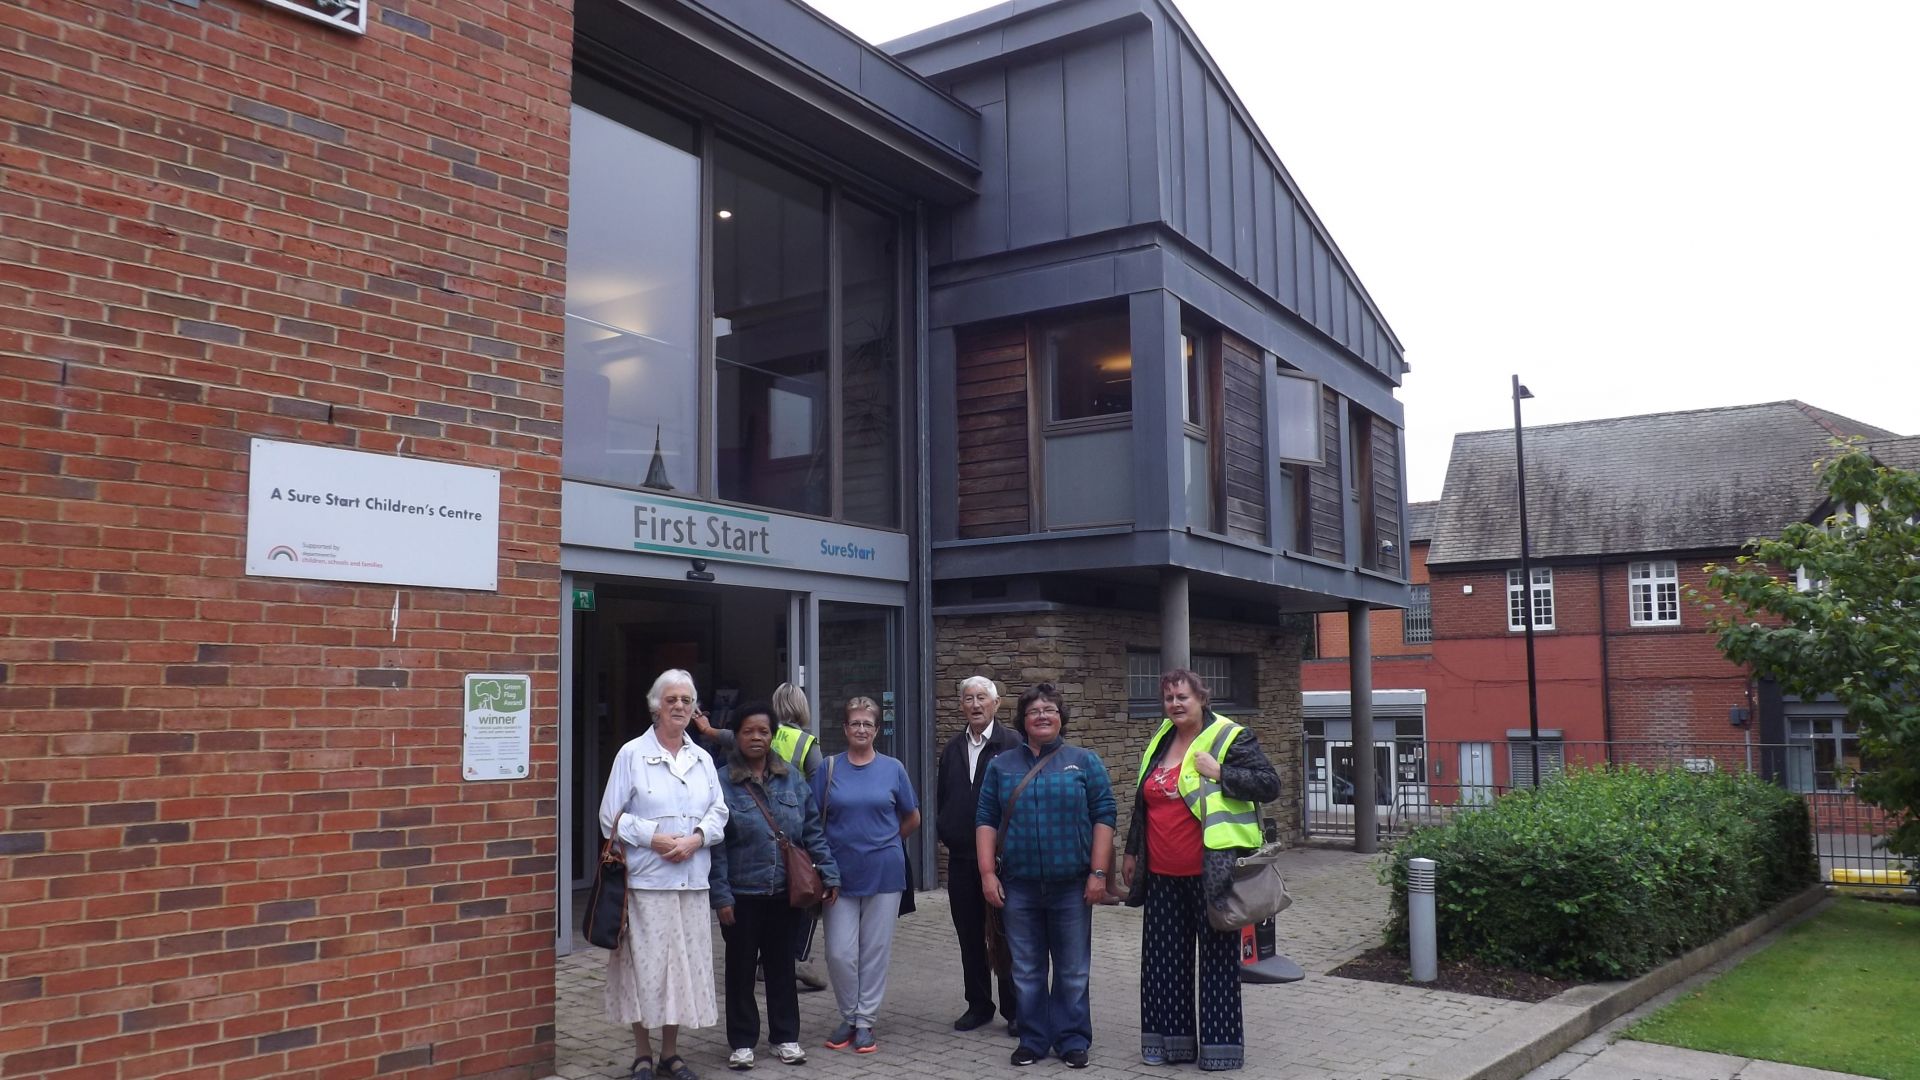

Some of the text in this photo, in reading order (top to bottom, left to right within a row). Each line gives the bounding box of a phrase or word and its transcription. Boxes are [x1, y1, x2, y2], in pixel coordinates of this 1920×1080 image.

[270, 487, 482, 521] A Sure Start Children's Centre
[633, 505, 770, 554] First Start
[820, 538, 876, 561] SureStart
[478, 713, 517, 725] winner
